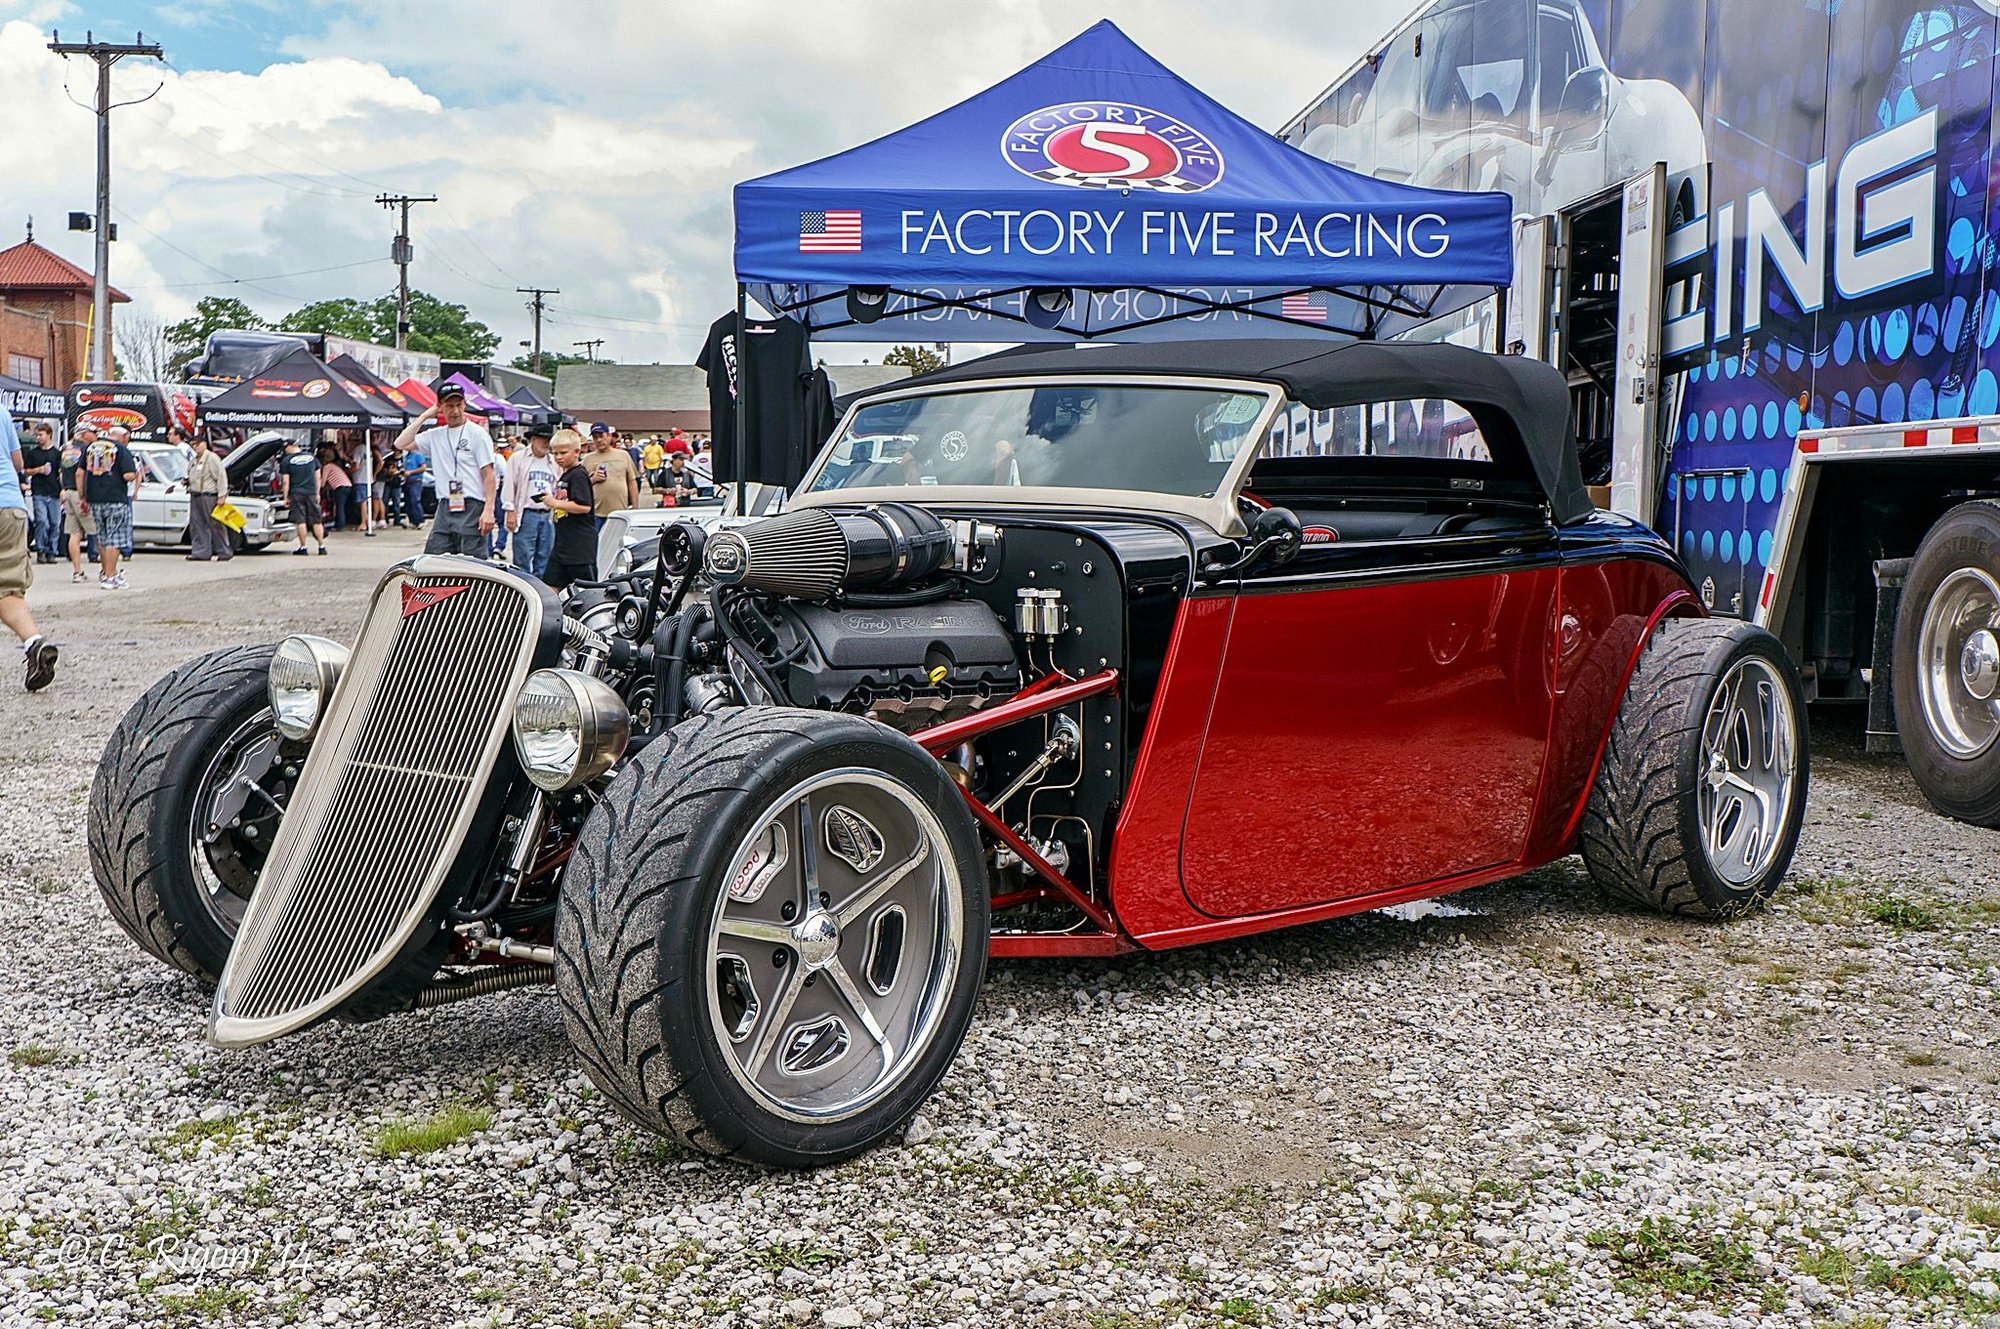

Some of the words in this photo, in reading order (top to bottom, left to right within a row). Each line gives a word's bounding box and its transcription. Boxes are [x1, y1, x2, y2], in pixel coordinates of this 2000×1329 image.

[1011, 107, 1155, 153] FACTORY
[1157, 125, 1215, 166] FIVE
[1075, 121, 1150, 177] 5
[901, 210, 1125, 255] FACTORY
[1142, 211, 1235, 256] FIVE
[1255, 212, 1450, 258] RACING
[205, 412, 228, 422] Online
[228, 412, 266, 423] Classifieds
[267, 412, 277, 422] for
[318, 413, 358, 424] Enthusiasts
[847, 614, 889, 632] Ford
